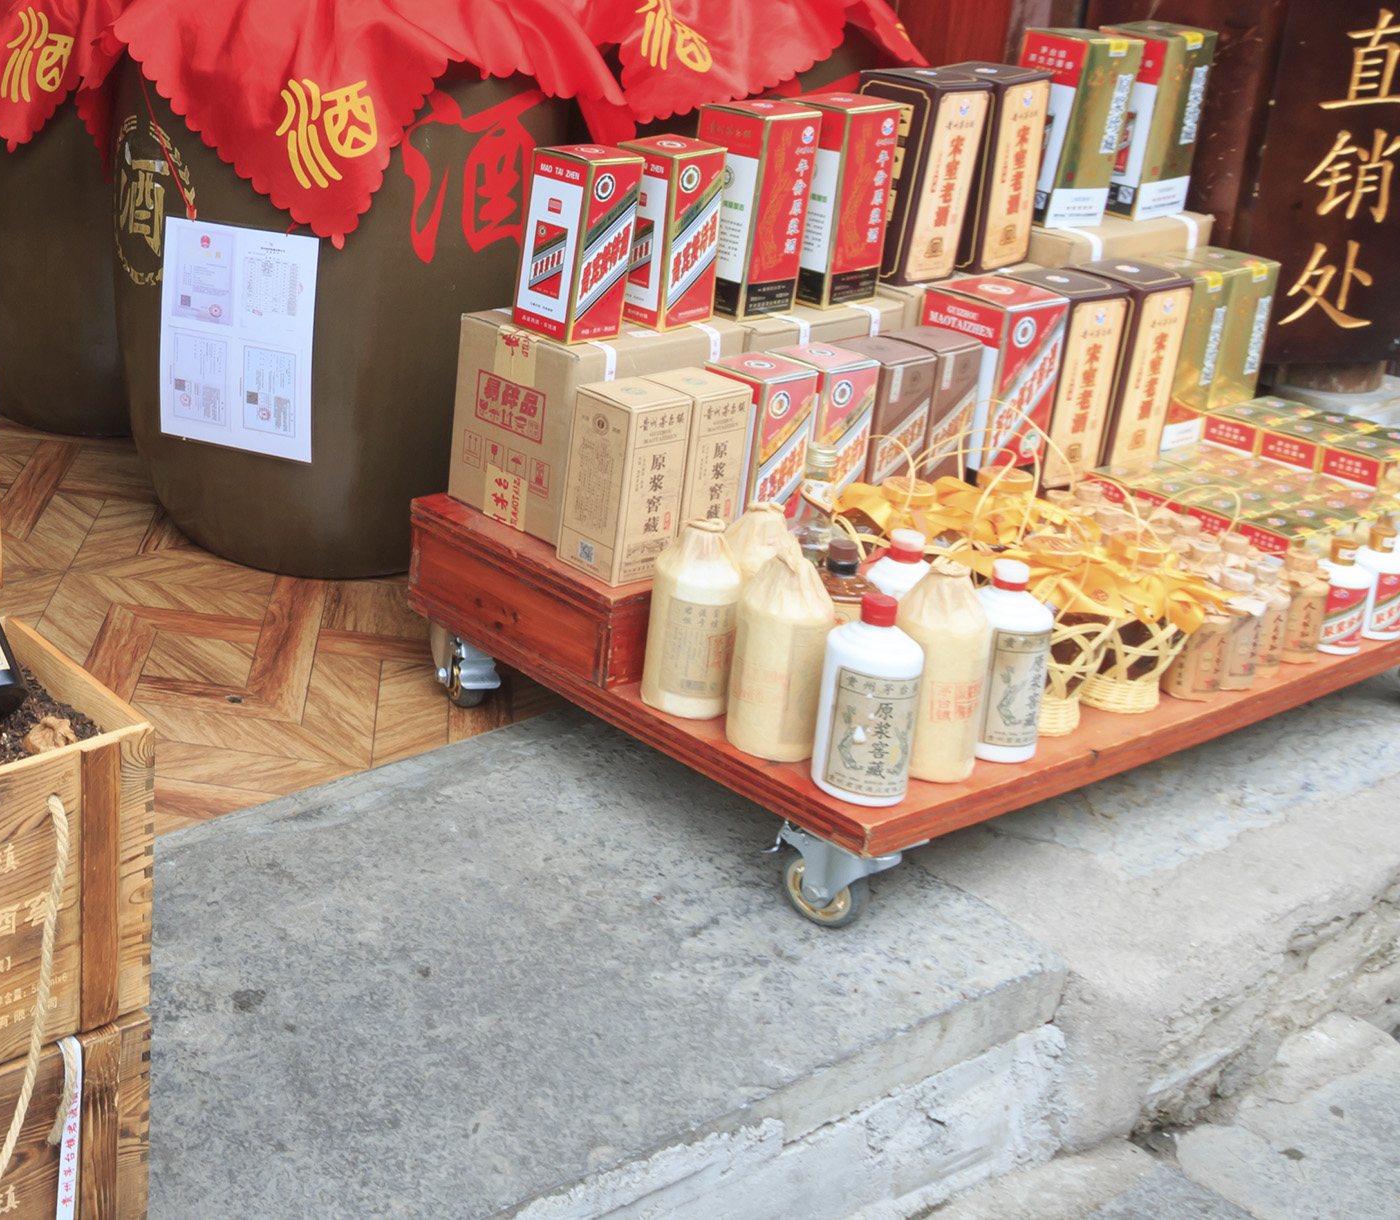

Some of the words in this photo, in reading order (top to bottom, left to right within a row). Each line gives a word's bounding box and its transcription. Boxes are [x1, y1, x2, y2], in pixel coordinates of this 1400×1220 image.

[0, 6, 75, 104] 酒
[275, 78, 378, 190] 酒
[540, 163, 552, 174] MAO
[555, 167, 563, 176] TAI
[566, 169, 580, 181] ZHEN
[650, 164, 665, 174] ZHEN
[1277, 8, 1400, 329] 直销处
[928, 310, 995, 339] MAOTAIZHEN
[484, 376, 538, 418] 易碎品
[642, 452, 668, 534] 原浆窖藏
[865, 702, 894, 780] 原浆窖藏
